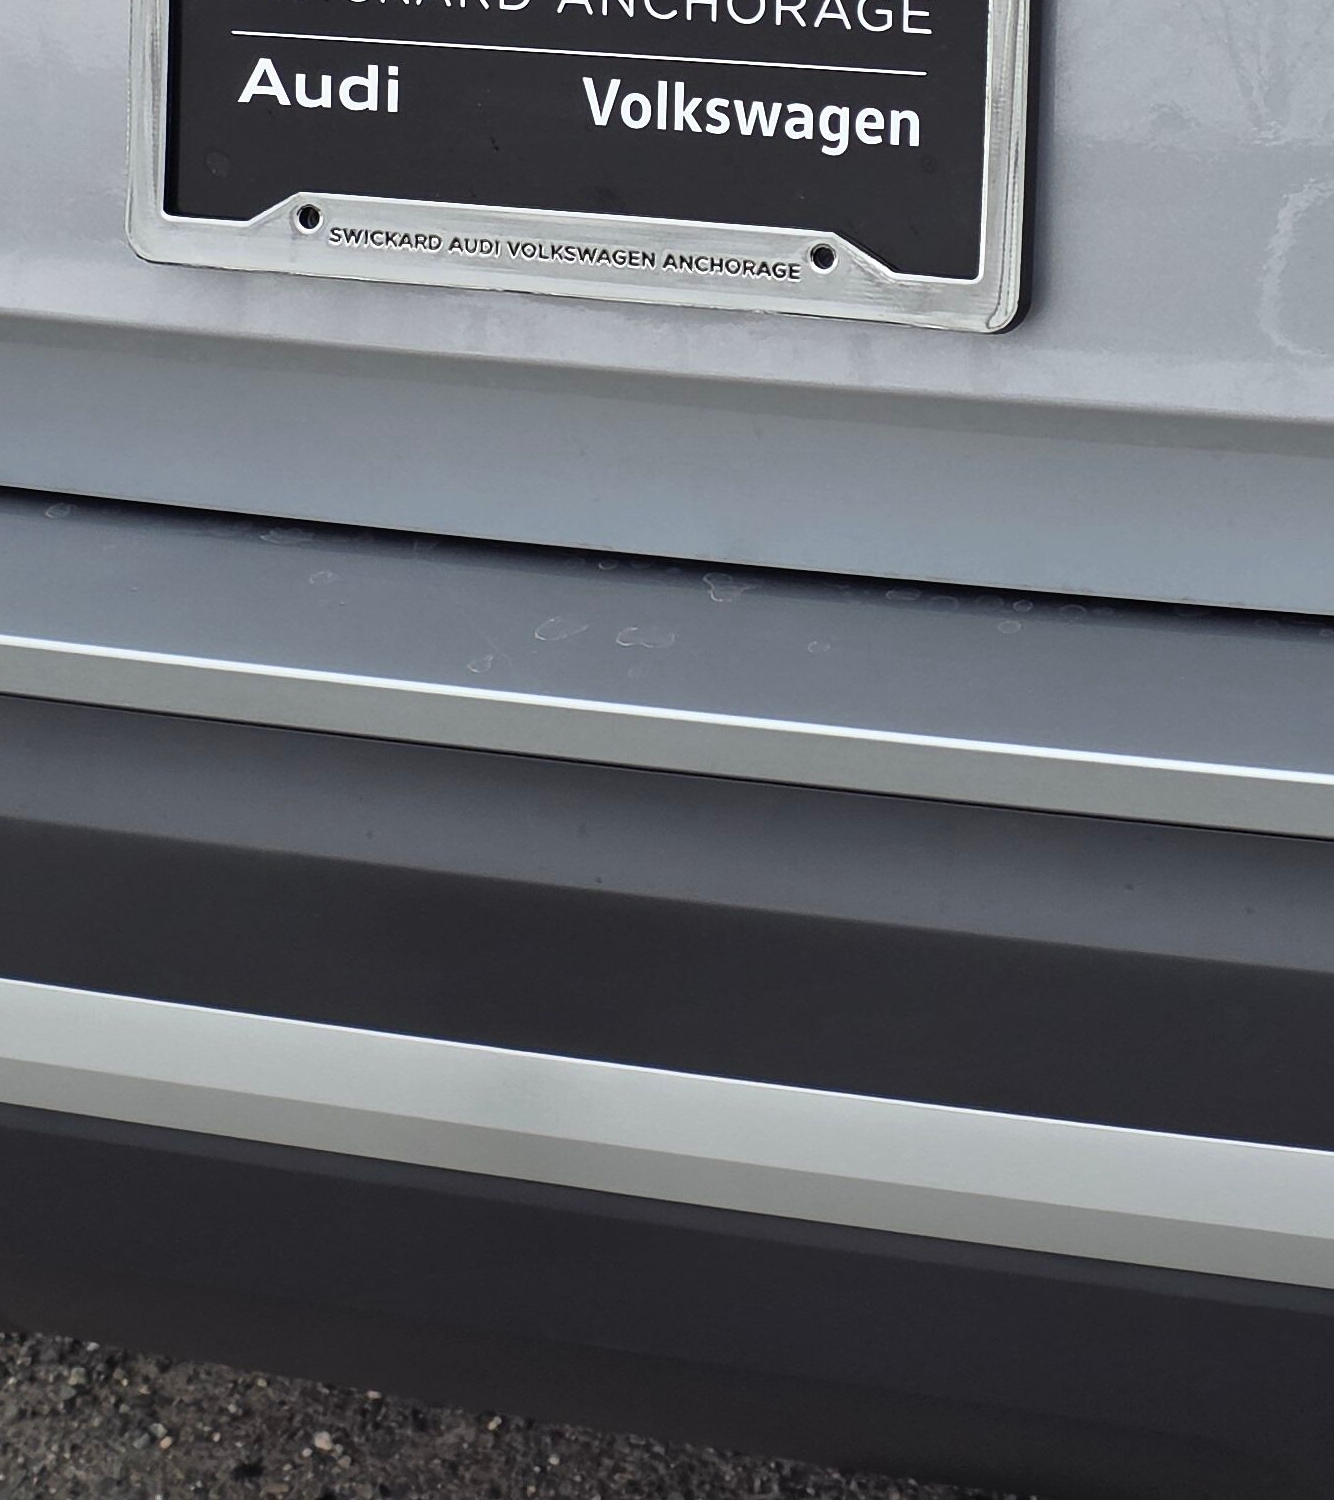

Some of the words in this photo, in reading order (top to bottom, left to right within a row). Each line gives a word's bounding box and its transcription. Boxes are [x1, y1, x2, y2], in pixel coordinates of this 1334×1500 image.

[237, 57, 400, 113] Audi
[582, 77, 921, 157] Volkswagen
[329, 227, 443, 252] SWICKARD
[448, 237, 501, 257] AUDI
[506, 241, 657, 270] VOLKSWAGEN
[662, 253, 803, 281] ANCHORAGE
